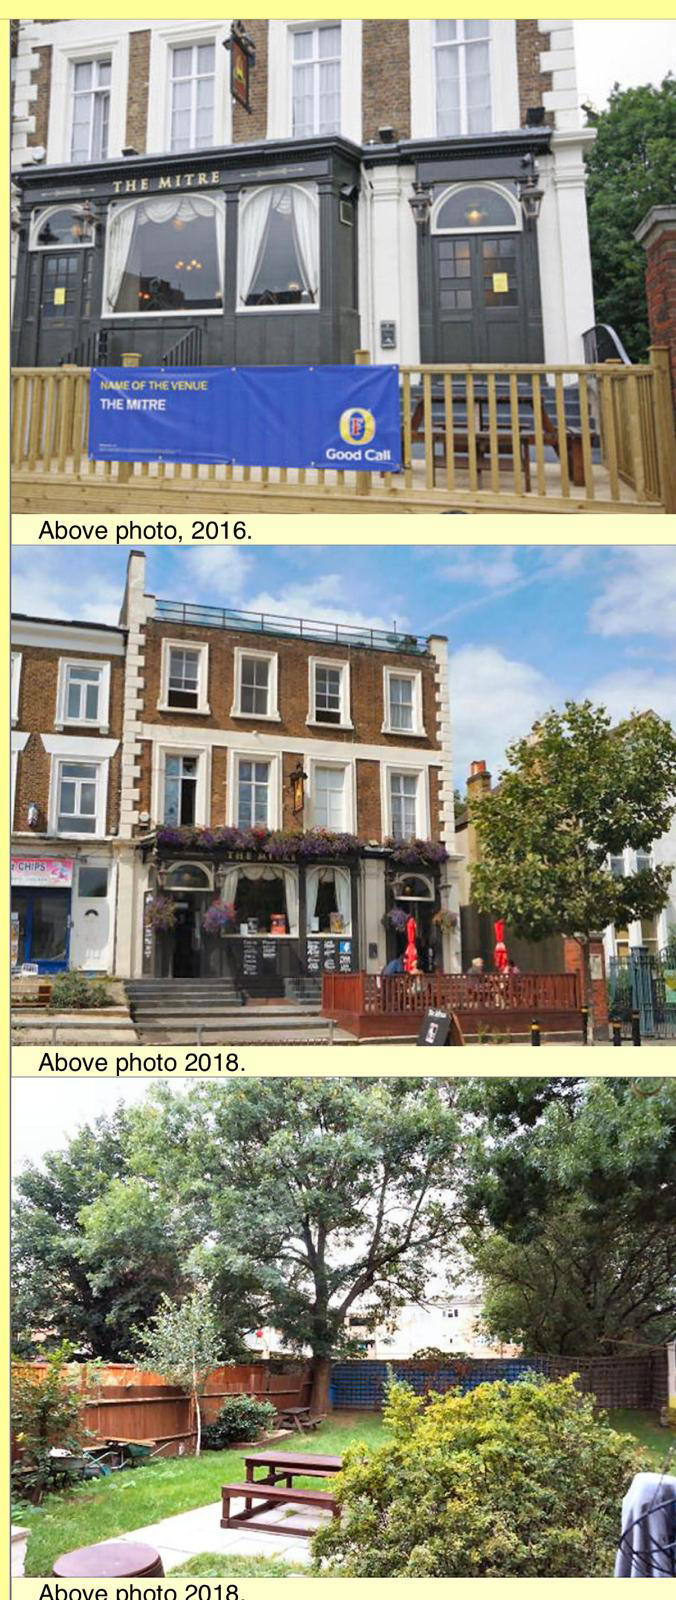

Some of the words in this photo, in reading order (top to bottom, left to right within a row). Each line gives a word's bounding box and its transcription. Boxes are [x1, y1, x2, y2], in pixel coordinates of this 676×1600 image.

[112, 178, 149, 193] THE
[158, 171, 220, 189] MITRE
[100, 380, 129, 391] NAME
[131, 380, 147, 391] OF
[148, 380, 169, 391] THE
[171, 380, 208, 391] VENUE
[100, 398, 124, 411] THE
[125, 398, 166, 411] MITRE
[326, 448, 362, 461] Good
[364, 448, 391, 462] Call
[226, 850, 252, 860] THE
[18, 861, 46, 872] CHIPS
